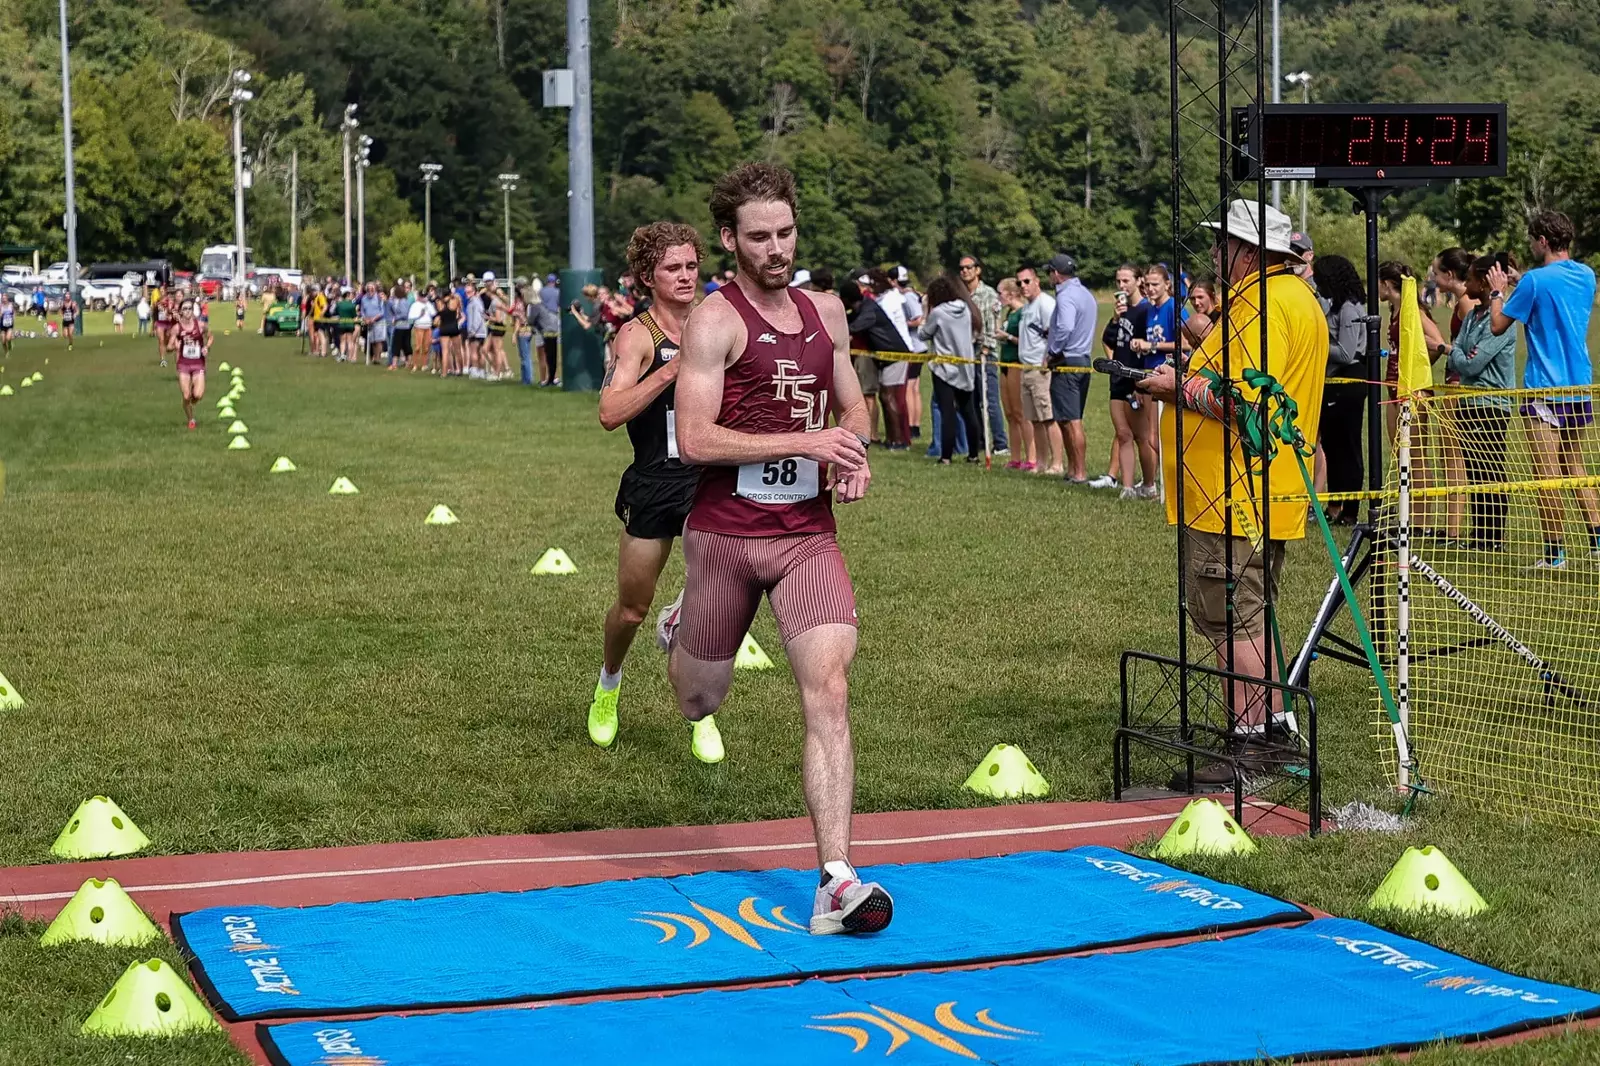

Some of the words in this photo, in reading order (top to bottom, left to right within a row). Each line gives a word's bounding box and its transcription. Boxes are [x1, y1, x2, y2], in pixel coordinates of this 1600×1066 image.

[770, 358, 828, 433] FSU
[761, 458, 798, 486] 58
[746, 492, 772, 501] CROSS
[773, 492, 808, 501] COUNTRY
